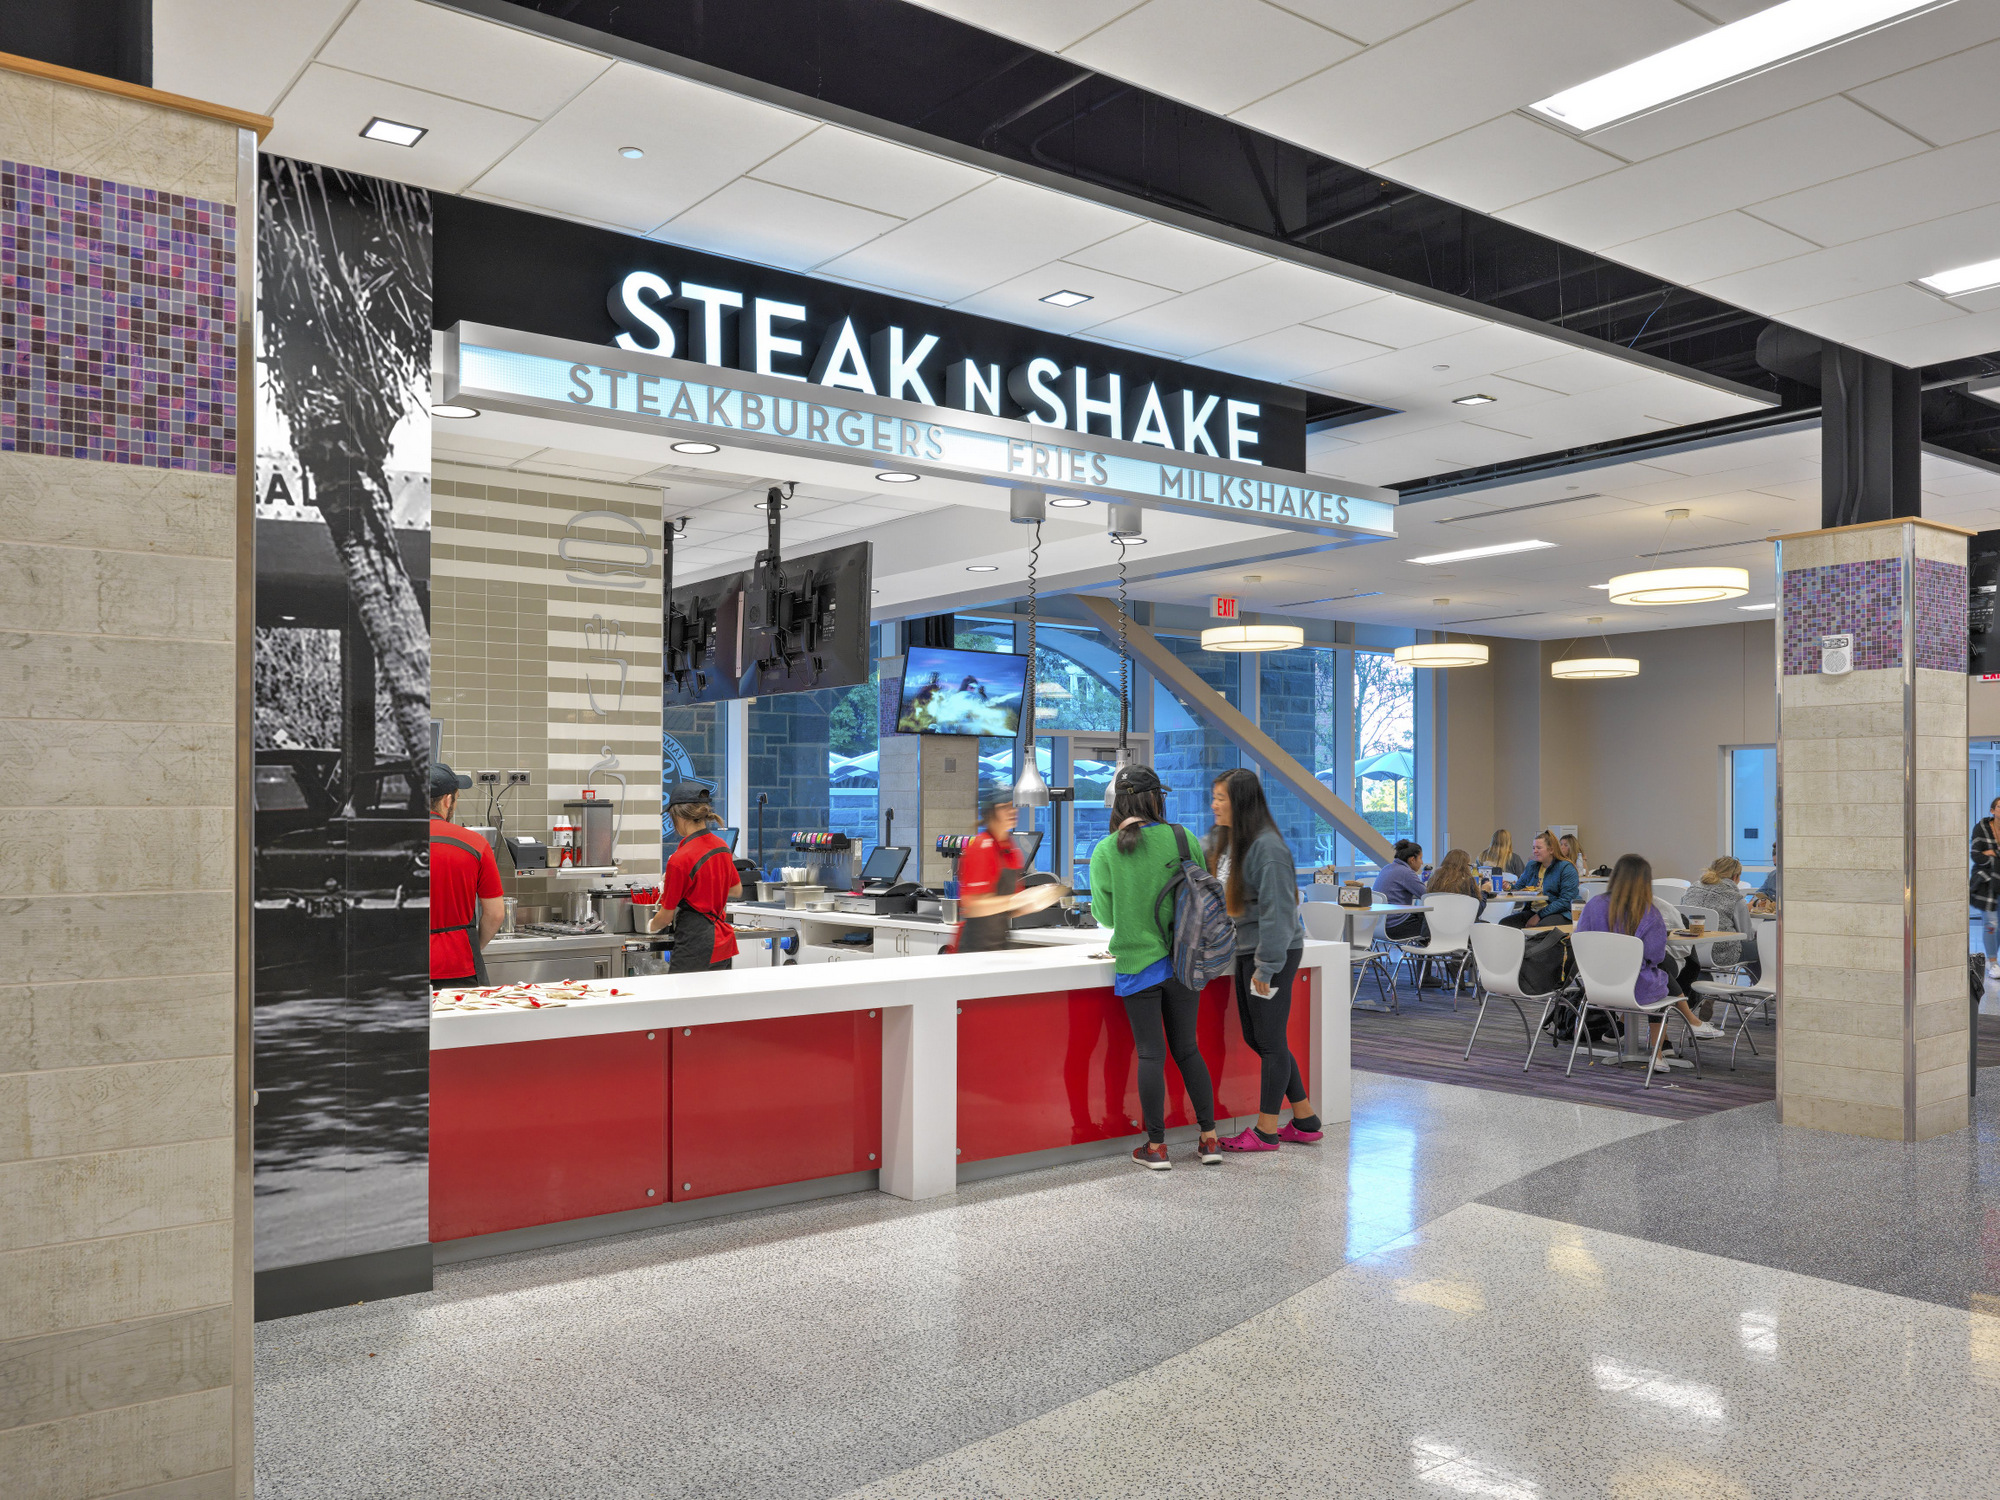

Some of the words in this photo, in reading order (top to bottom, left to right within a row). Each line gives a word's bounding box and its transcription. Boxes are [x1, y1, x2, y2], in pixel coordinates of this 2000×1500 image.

[614, 270, 940, 407] STEAK
[965, 357, 1001, 417] N
[1026, 357, 1263, 466] SHAKE
[256, 472, 322, 507] AL
[567, 364, 946, 459] STEAKBURGERS
[1007, 439, 1109, 486] FRIES
[1159, 465, 1350, 525] MILKSHAKES
[1217, 597, 1236, 617] EXIT
